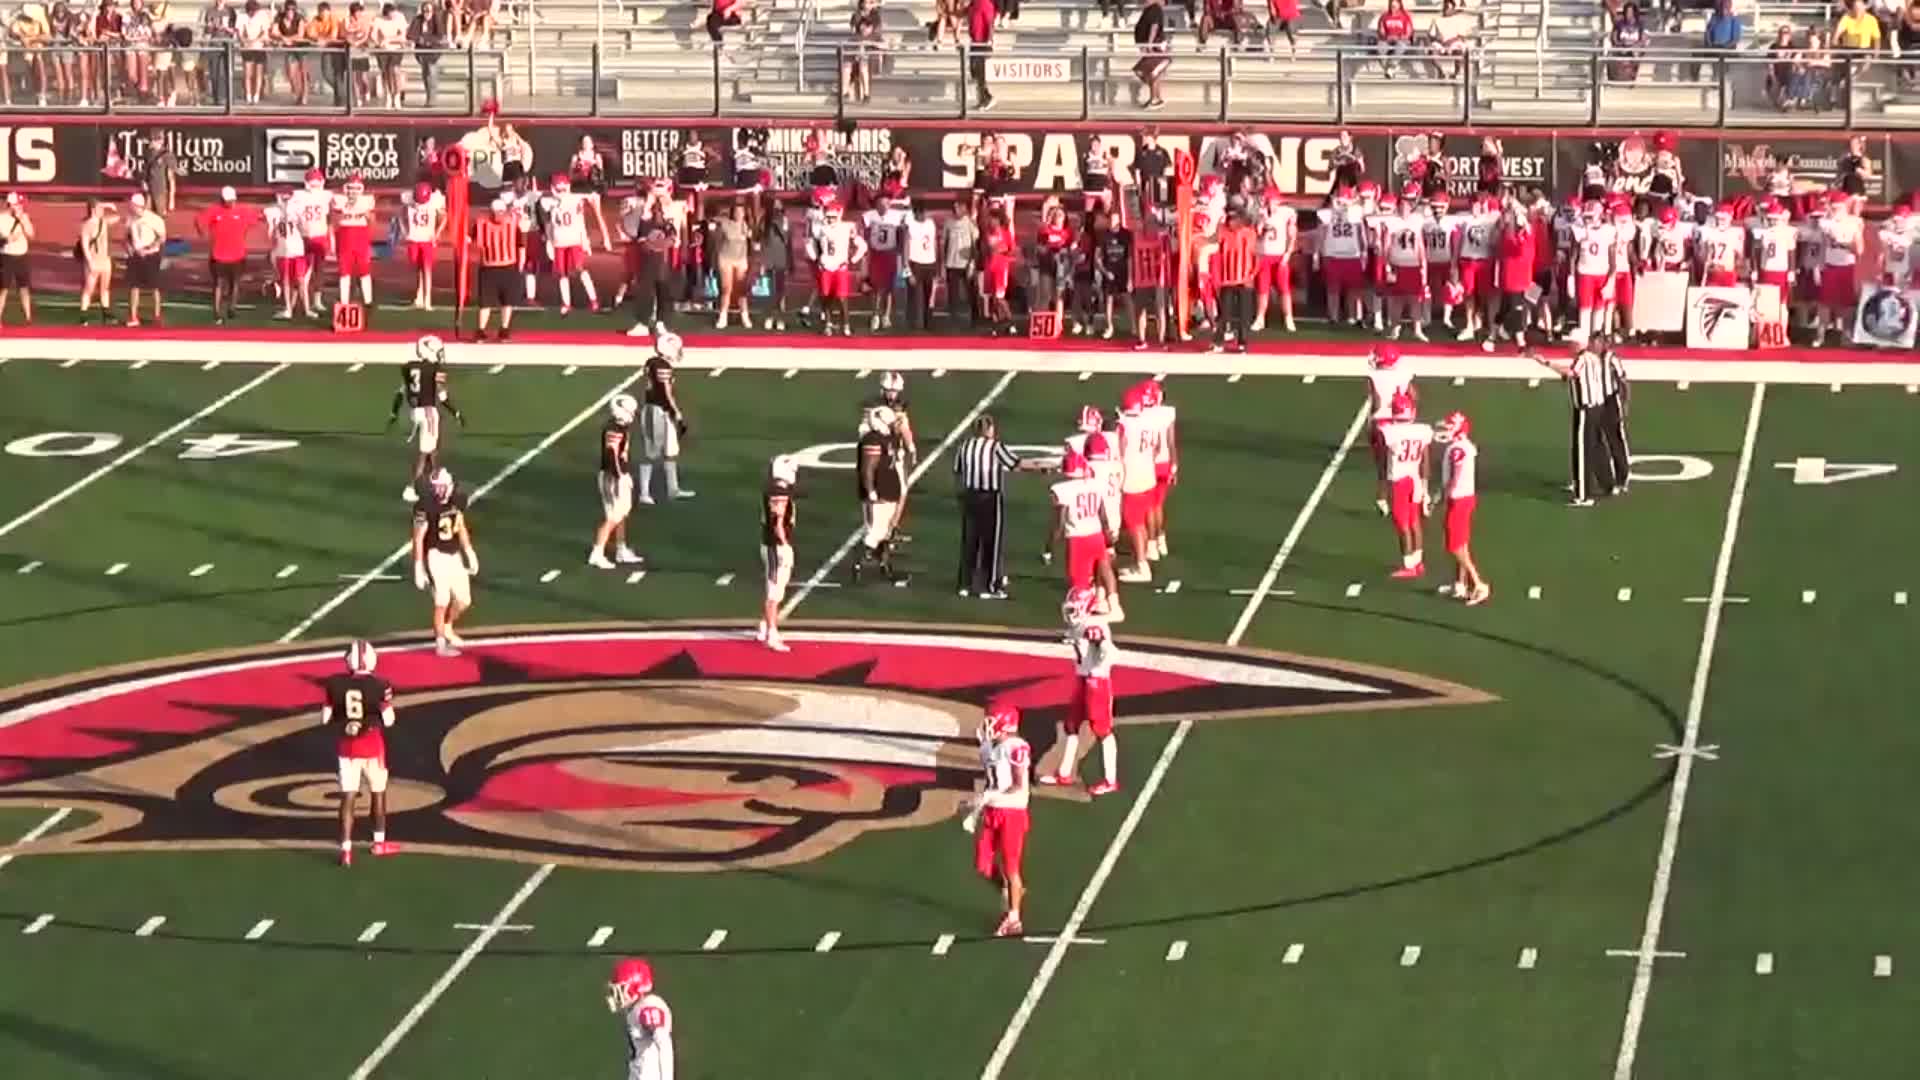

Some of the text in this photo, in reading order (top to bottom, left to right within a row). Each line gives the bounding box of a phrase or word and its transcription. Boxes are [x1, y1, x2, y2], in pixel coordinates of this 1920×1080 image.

[993, 63, 1063, 79] VISITORS
[118, 129, 224, 157] Trlium
[327, 133, 398, 151] SCOTT
[622, 130, 679, 151] BETTER
[193, 156, 251, 173] School
[327, 150, 398, 167] PRYOR
[1332, 223, 1353, 238] 52
[336, 306, 359, 328] 40
[1032, 314, 1055, 337] 50
[1760, 322, 1784, 345] 40
[409, 368, 421, 393] 3
[1398, 439, 1422, 462] 33
[345, 688, 363, 720] 6
